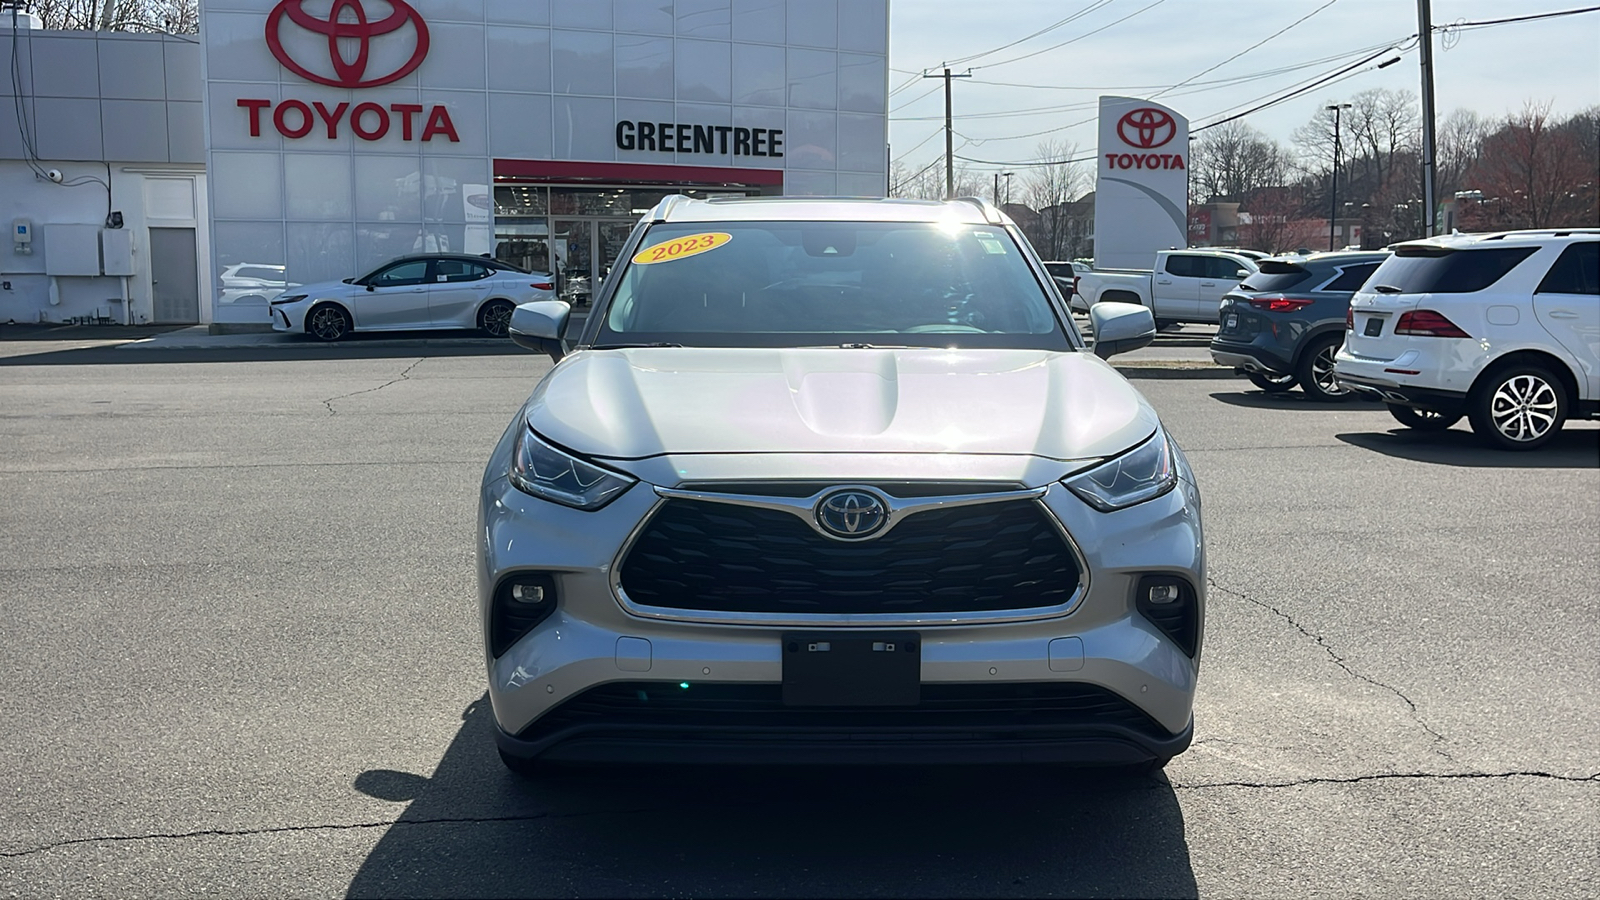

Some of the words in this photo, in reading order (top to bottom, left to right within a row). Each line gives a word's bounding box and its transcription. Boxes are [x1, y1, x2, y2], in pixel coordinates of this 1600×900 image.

[237, 99, 460, 142] TOYOTA
[616, 120, 784, 157] GREENTREE
[1105, 153, 1185, 170] TOYOTA
[652, 234, 715, 261] 2023
